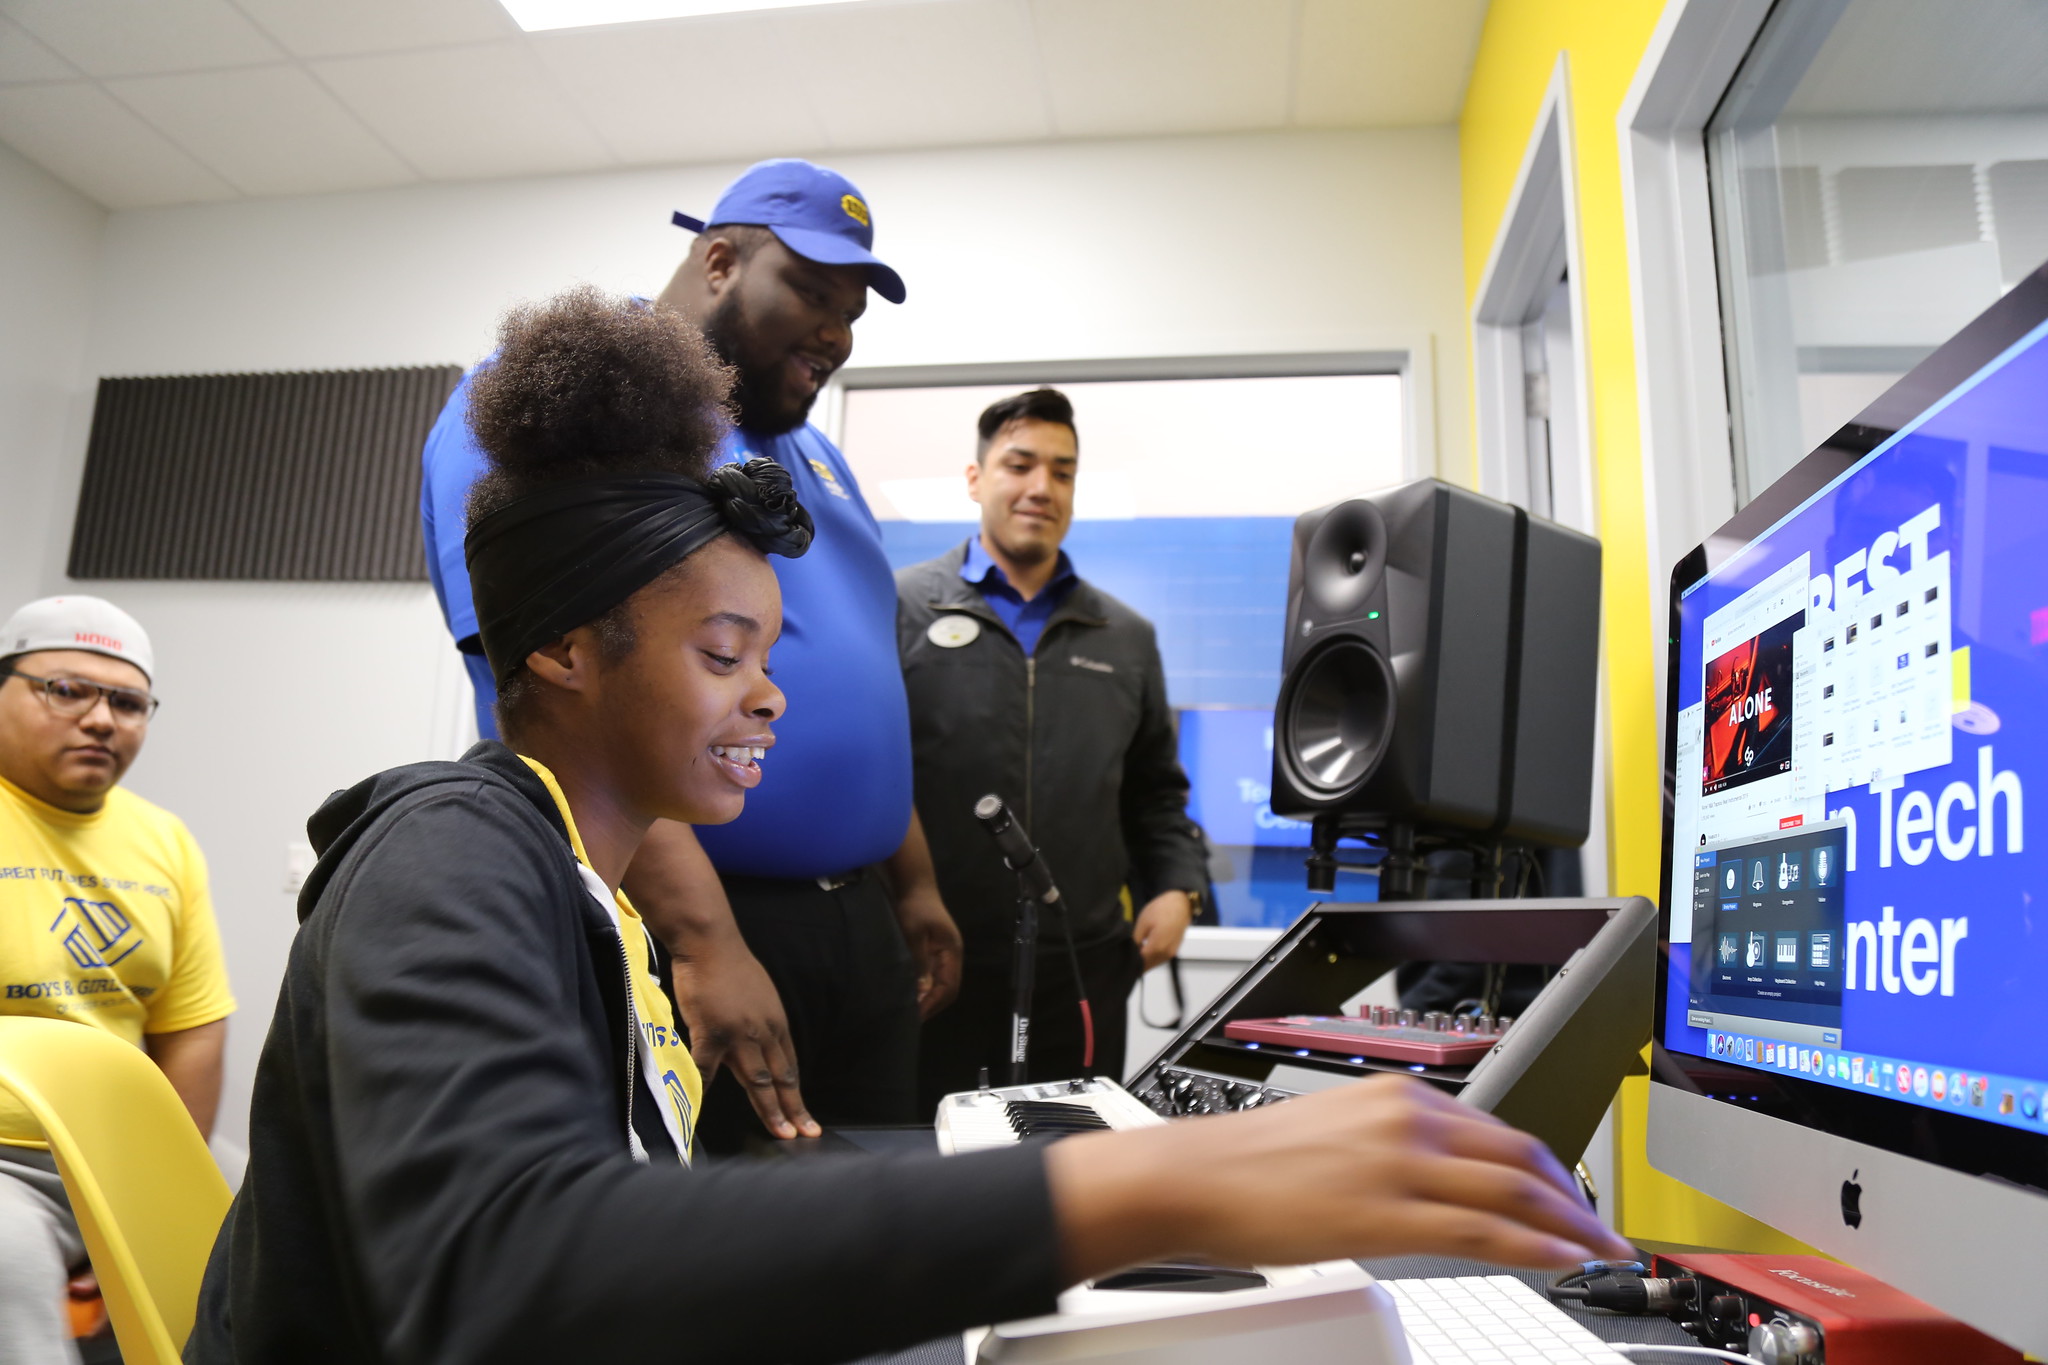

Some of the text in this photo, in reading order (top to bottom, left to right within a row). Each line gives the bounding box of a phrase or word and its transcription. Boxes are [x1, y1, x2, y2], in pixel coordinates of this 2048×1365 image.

[1728, 687, 1772, 727] ALONE
[1237, 779, 1270, 803] Te
[1869, 743, 2024, 867] Tech
[1845, 906, 1969, 997] nter
[6, 982, 62, 999] BOYS
[65, 980, 74, 996] &
[77, 979, 123, 996] GIRL
